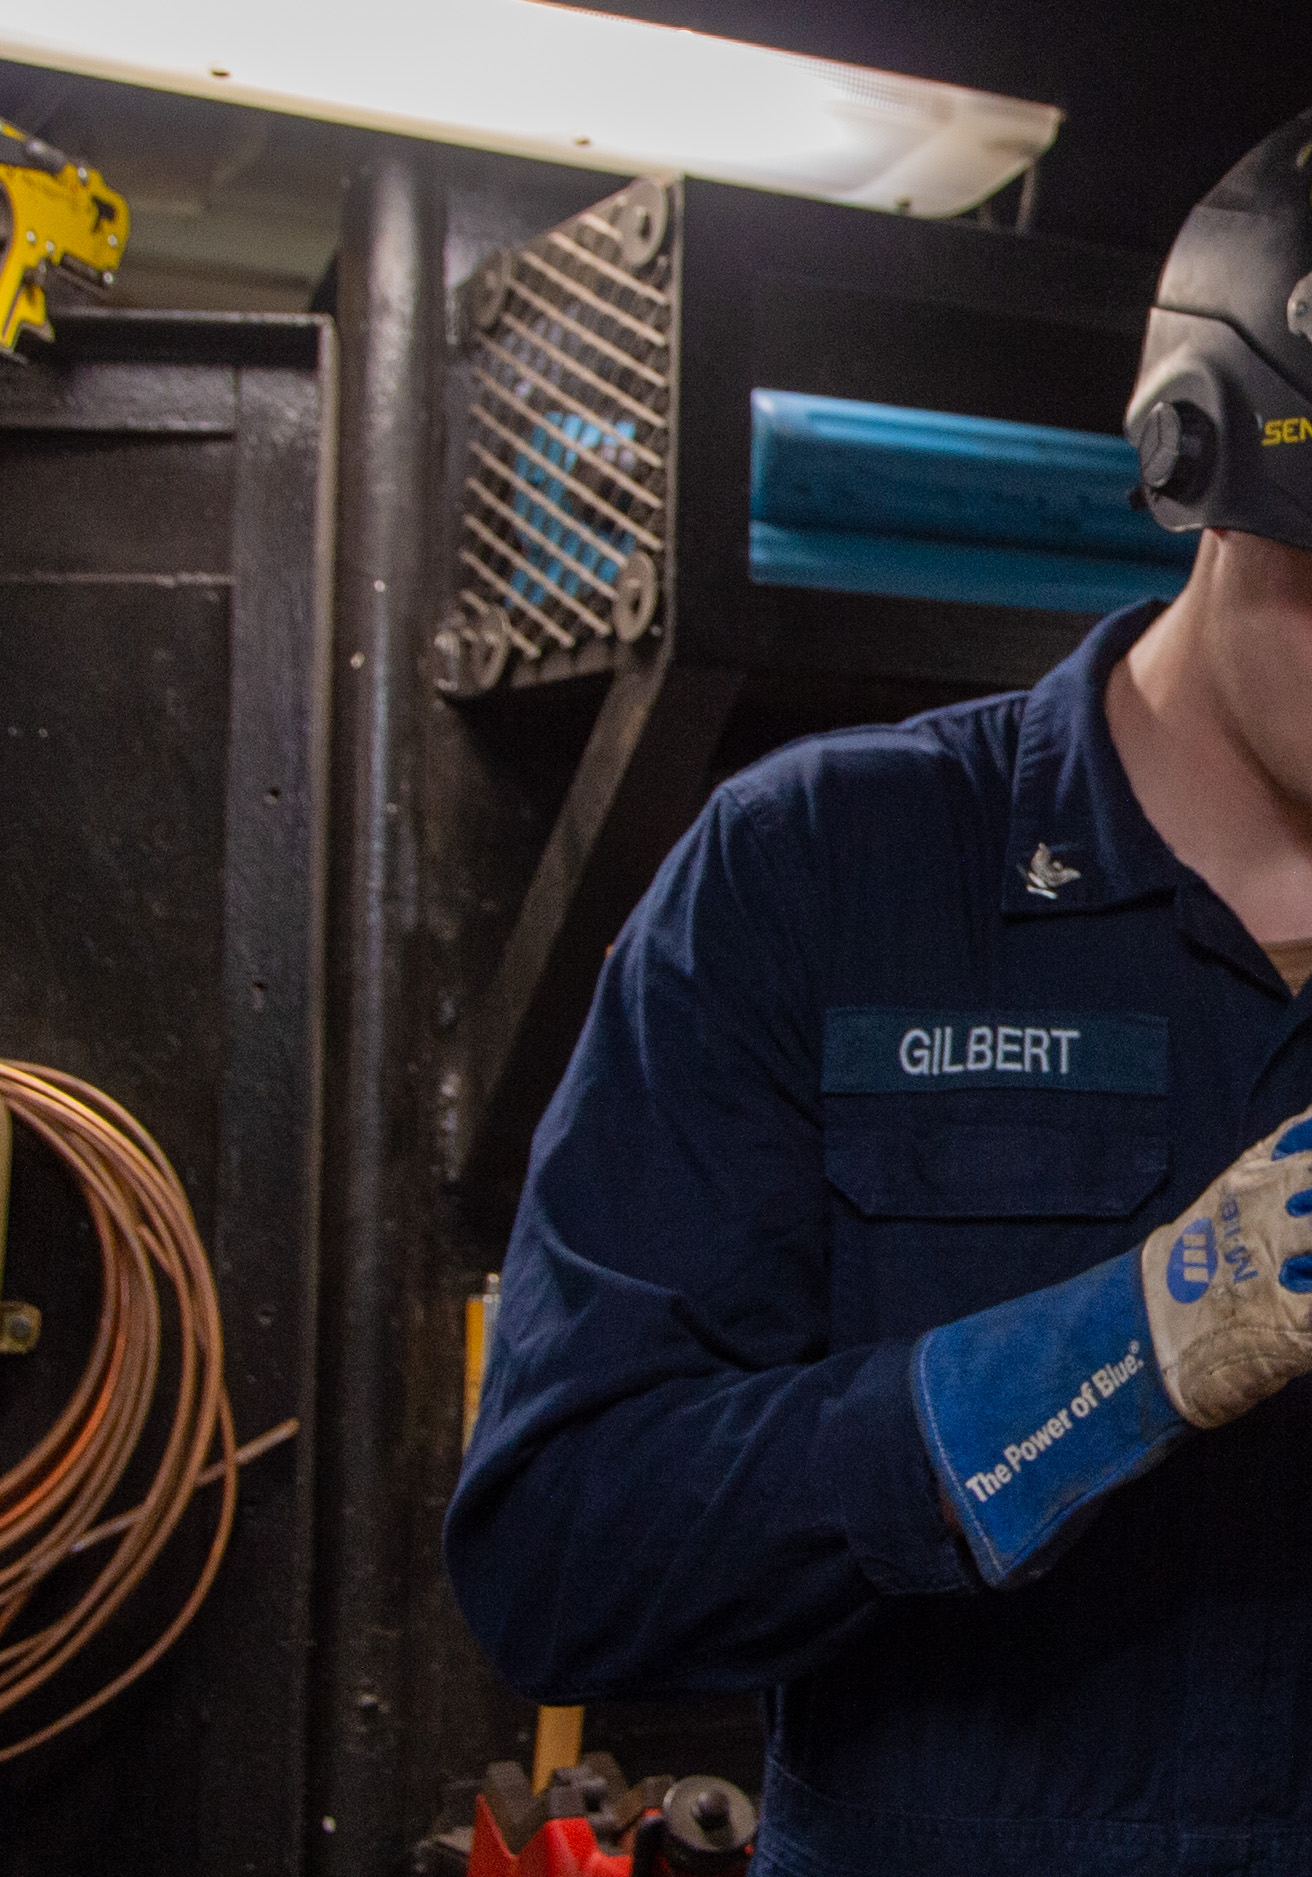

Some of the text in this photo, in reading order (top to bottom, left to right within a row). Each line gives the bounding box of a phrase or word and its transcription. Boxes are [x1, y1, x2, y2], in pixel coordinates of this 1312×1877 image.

[898, 1026, 1081, 1076] GILBERT
[965, 1463, 1013, 1502] The
[1003, 1408, 1073, 1473] Power
[1070, 1381, 1099, 1418] of
